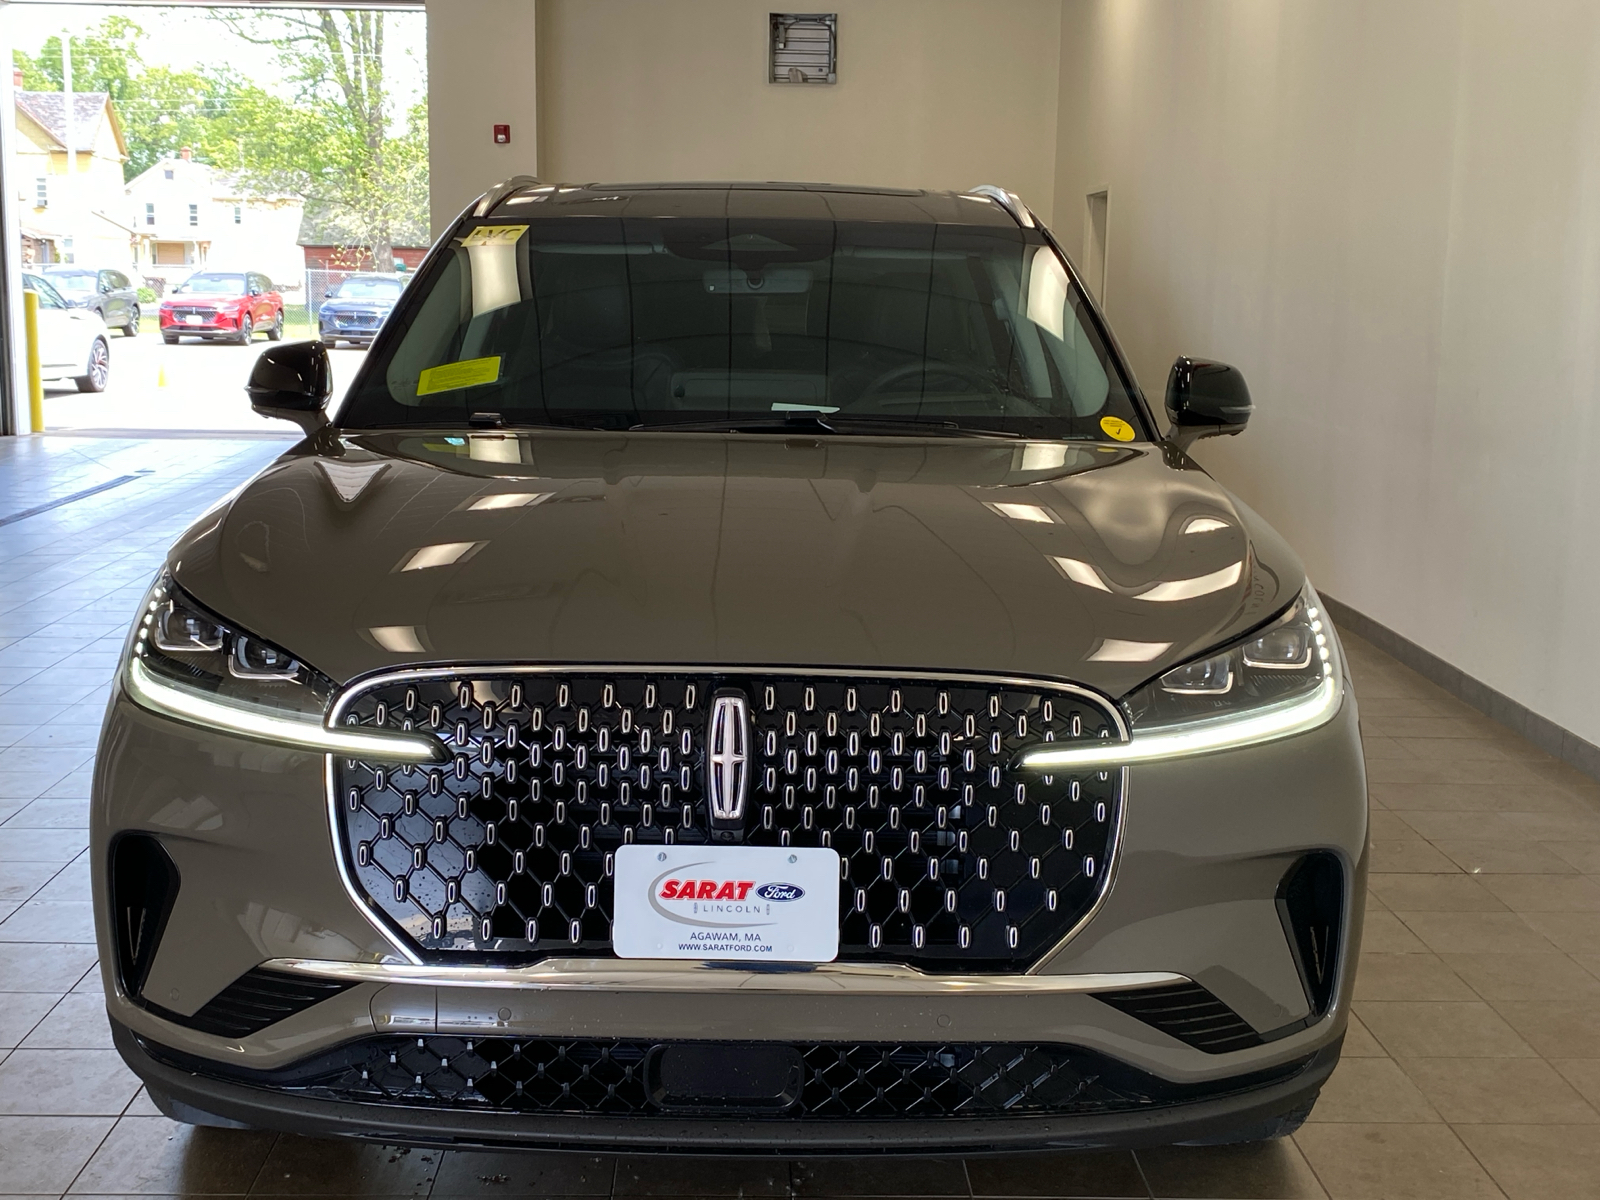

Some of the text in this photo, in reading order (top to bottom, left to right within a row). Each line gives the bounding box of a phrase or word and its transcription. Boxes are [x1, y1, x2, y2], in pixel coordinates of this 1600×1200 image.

[659, 879, 796, 901] SARAT Ford
[703, 905, 760, 913] LINCOLN
[690, 932, 761, 942] AGAWAM, MA
[678, 943, 773, 952] WWW.SARATFORD.COM
